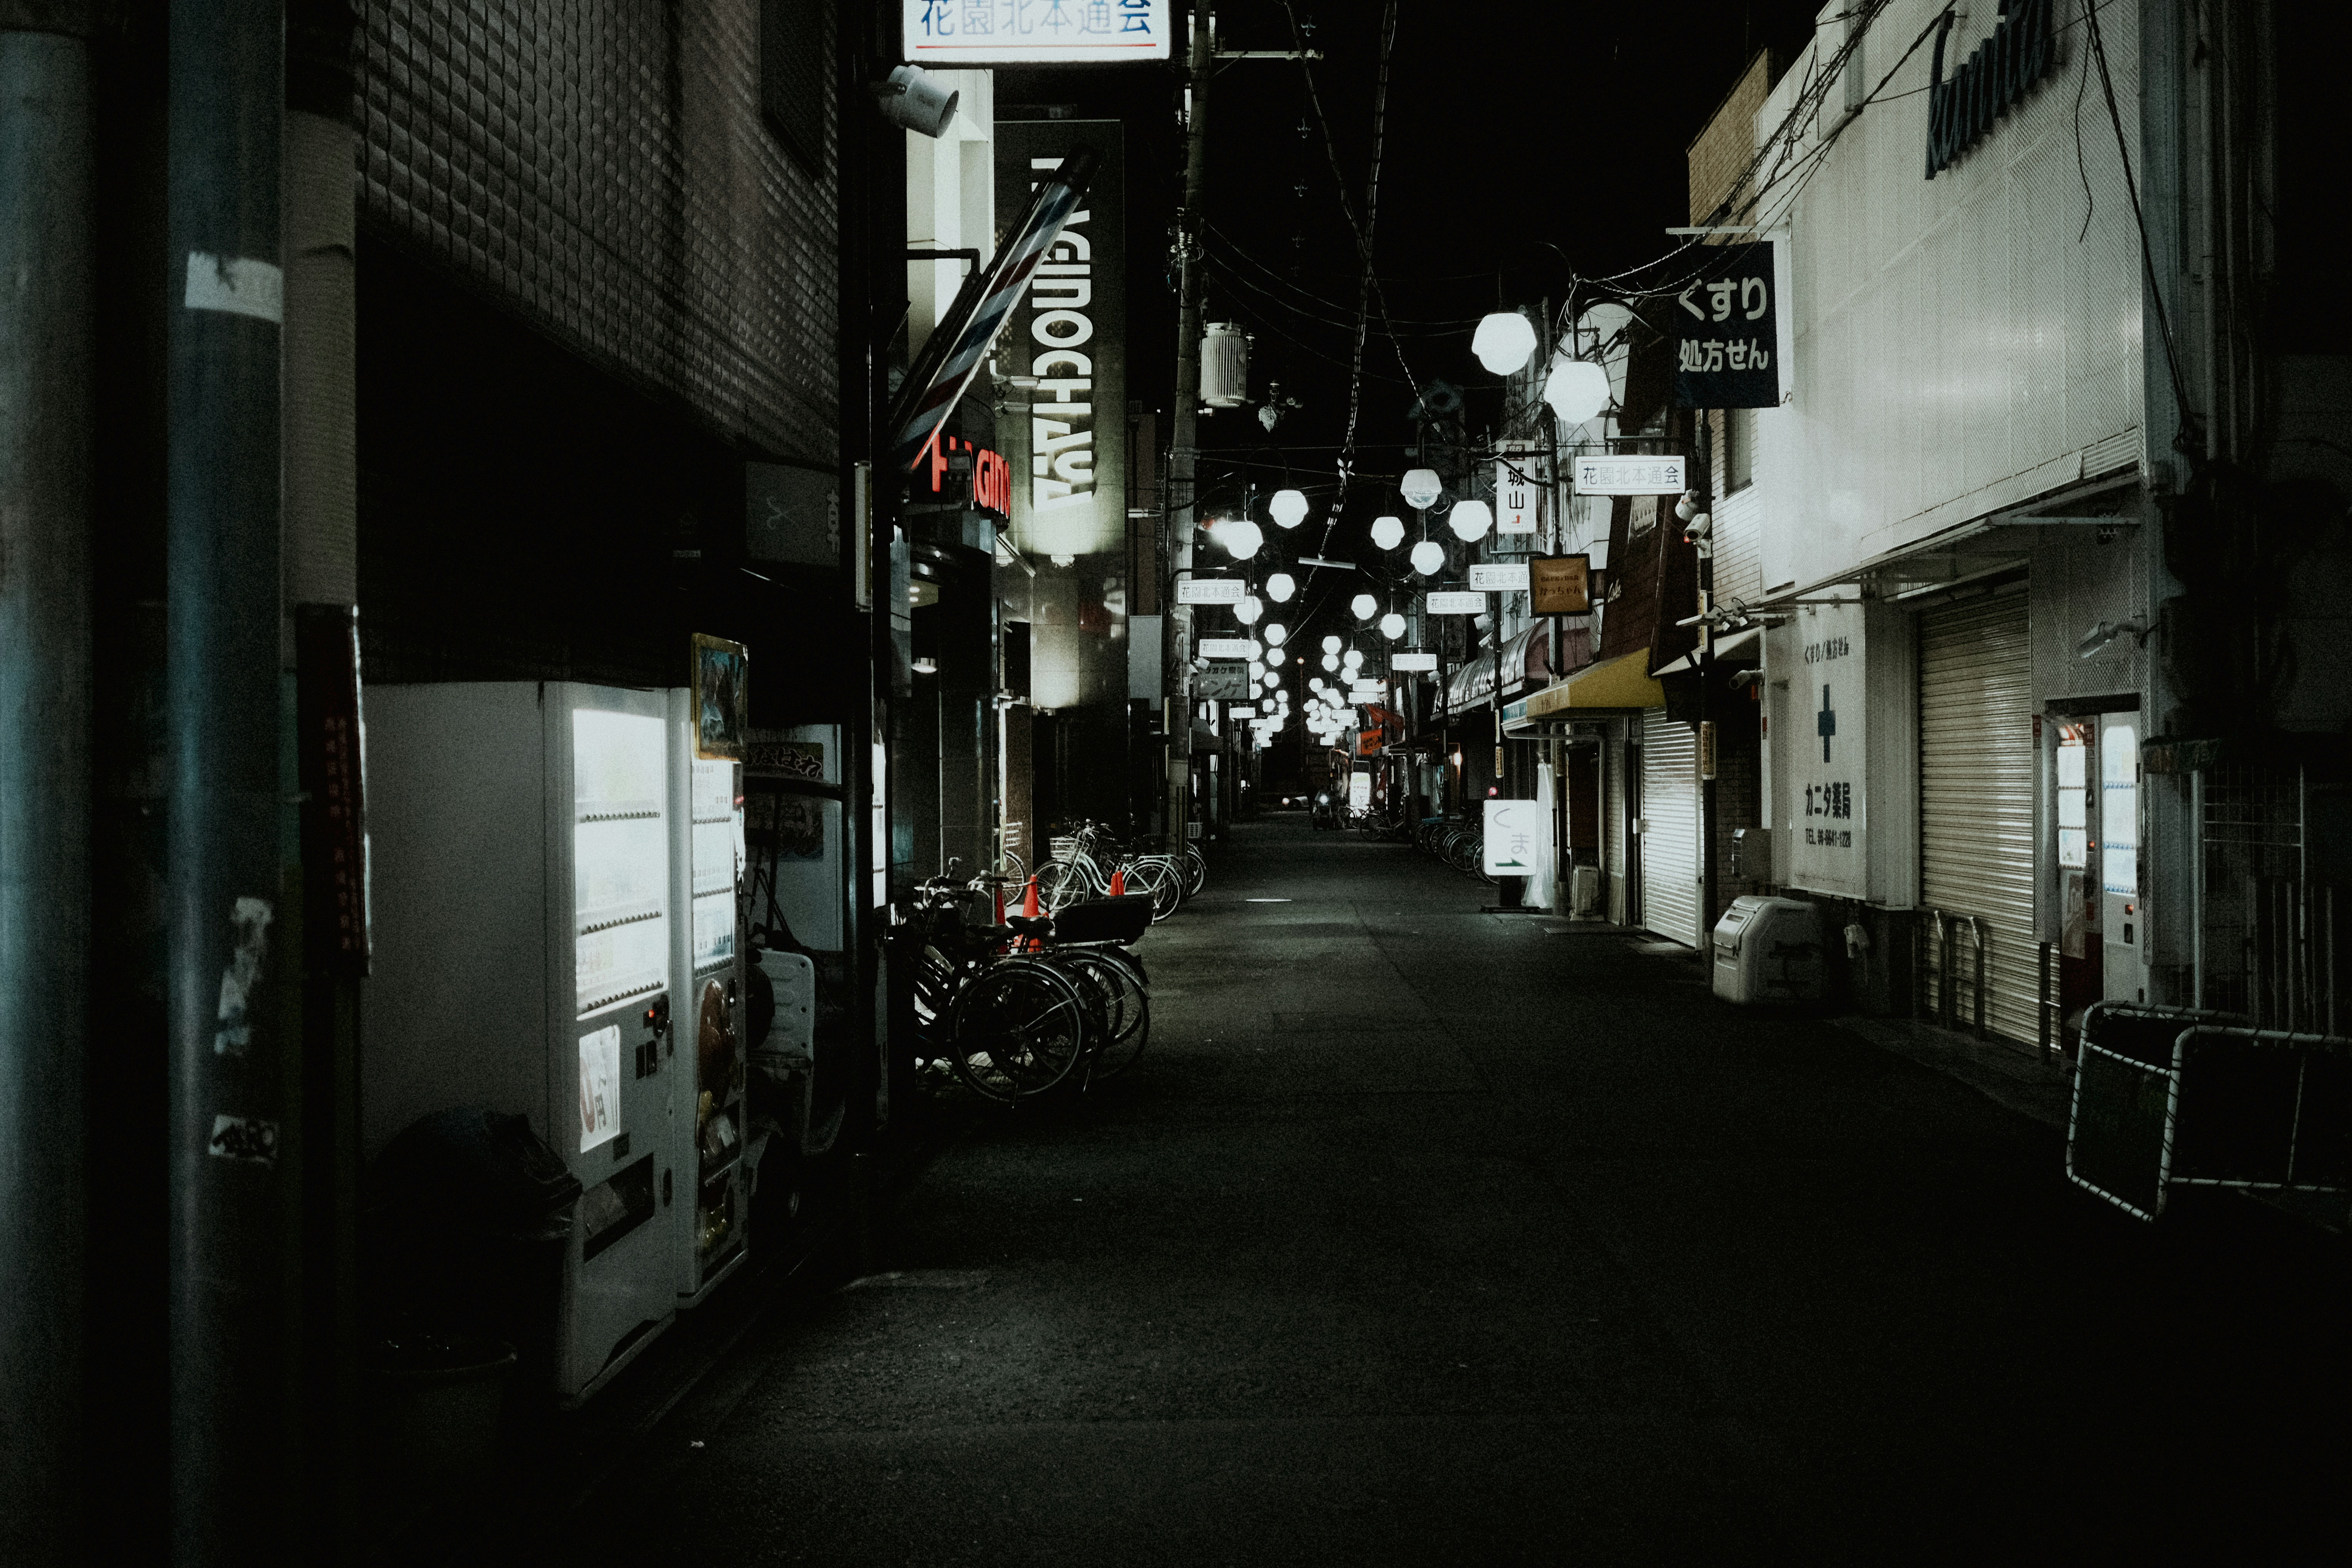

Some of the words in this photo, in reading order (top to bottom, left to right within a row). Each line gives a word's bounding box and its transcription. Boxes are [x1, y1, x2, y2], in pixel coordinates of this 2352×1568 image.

[921, 0, 1151, 36] 花園北本通会
[1679, 277, 1767, 322] くすり
[1679, 338, 1768, 373] 処方せん
[1584, 465, 1679, 485] 花園北本通会
[1182, 586, 1240, 598] 花園北本通会
[1475, 572, 1528, 585] 花園北本通
[1431, 597, 1482, 608] 花園北本通会
[1805, 781, 1850, 820] カニタ薬局
